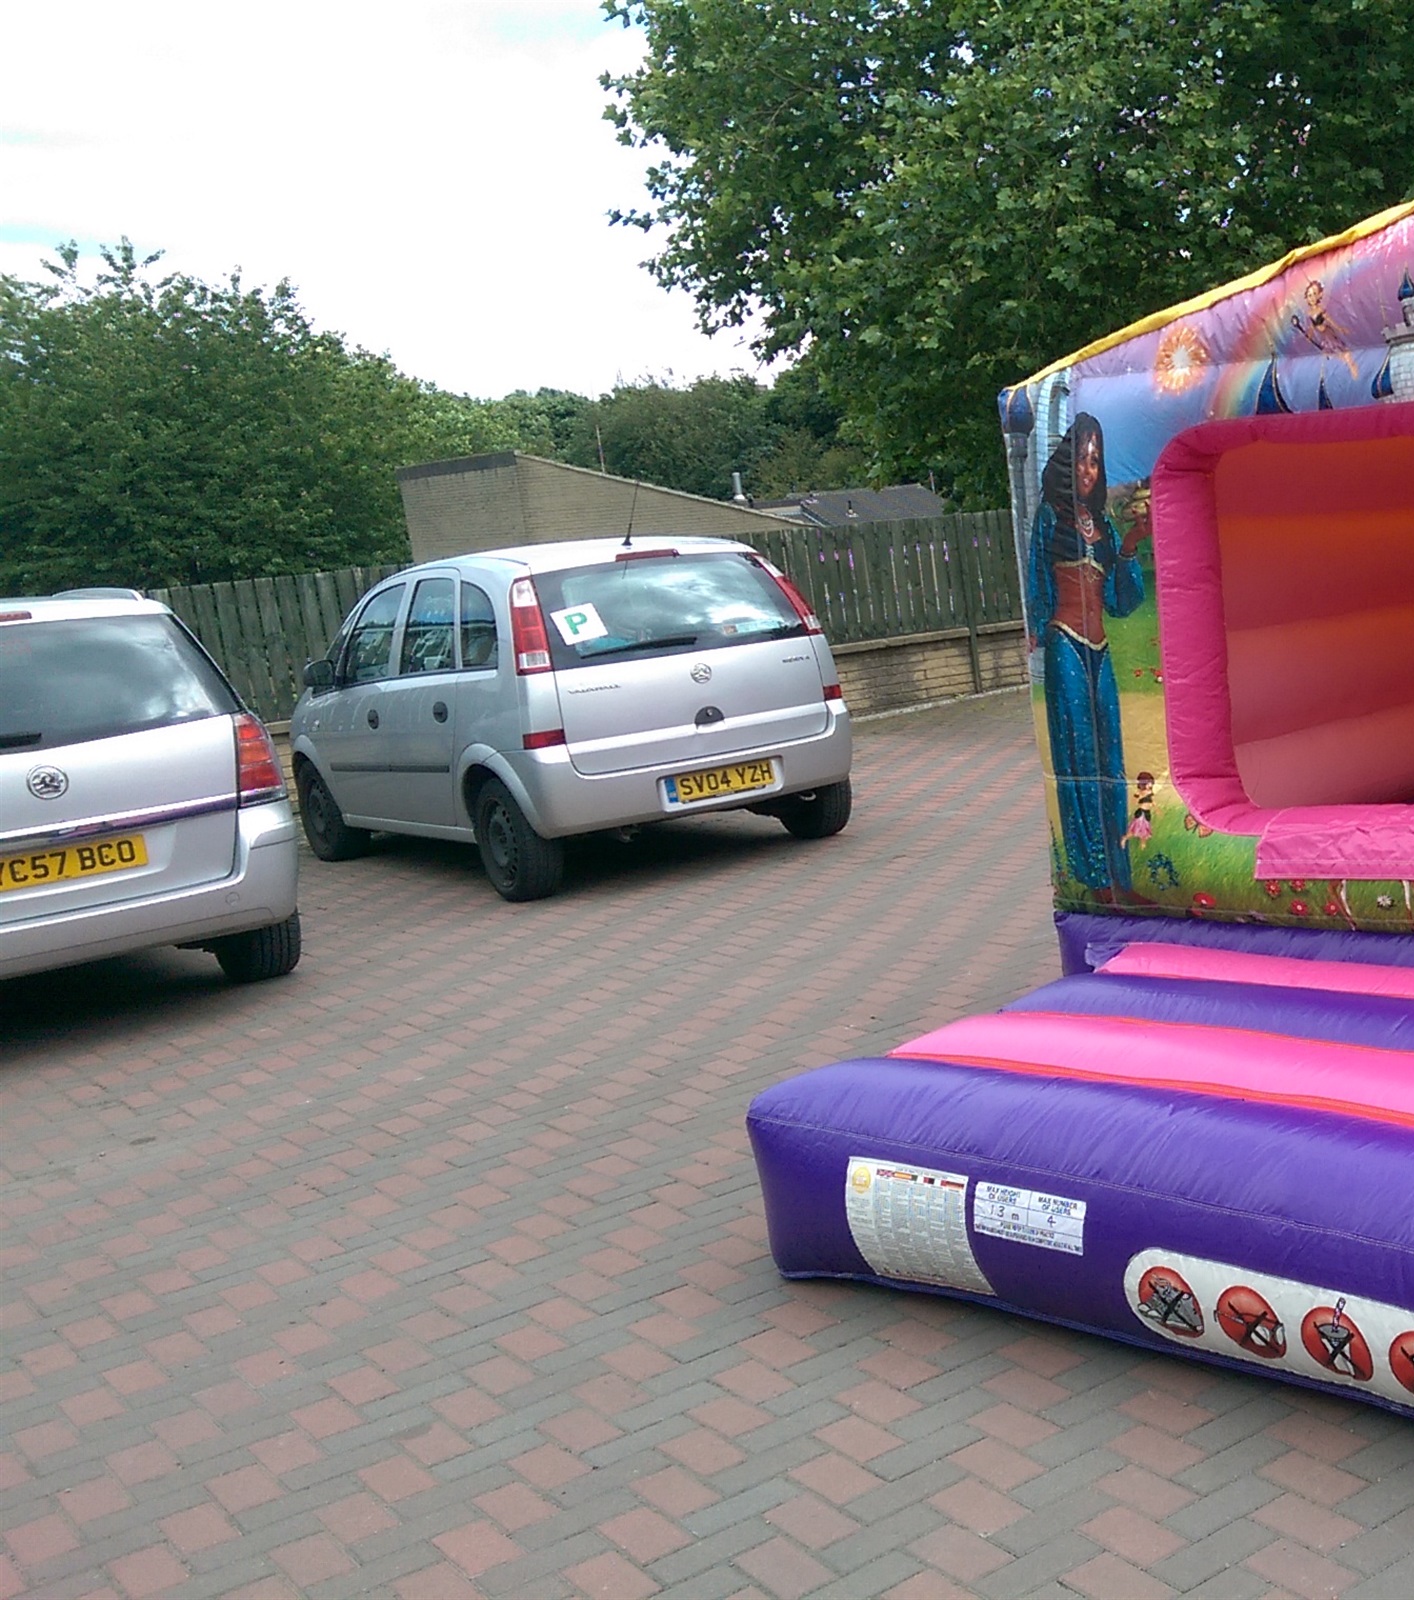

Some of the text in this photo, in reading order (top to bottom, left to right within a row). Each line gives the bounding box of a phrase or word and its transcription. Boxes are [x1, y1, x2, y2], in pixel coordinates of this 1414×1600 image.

[564, 612, 588, 636] P
[679, 763, 773, 796] SV04 YZH
[76, 839, 136, 872] BCO
[1046, 1215, 1057, 1229] 4
